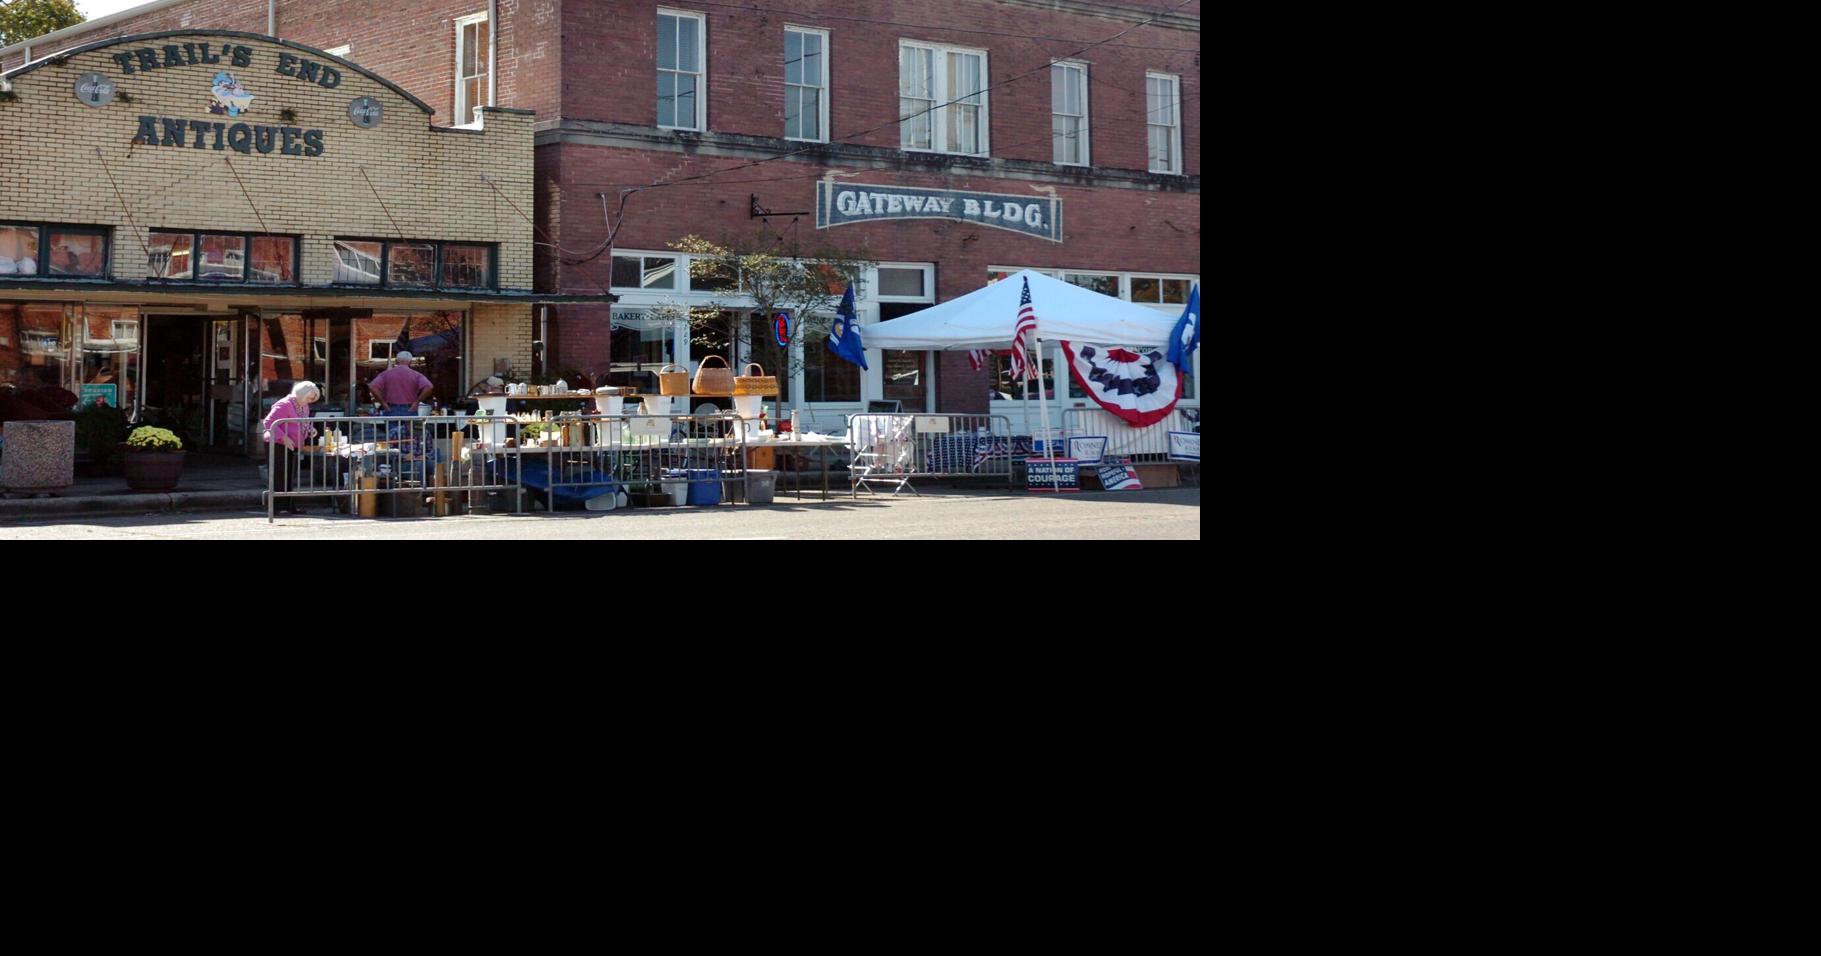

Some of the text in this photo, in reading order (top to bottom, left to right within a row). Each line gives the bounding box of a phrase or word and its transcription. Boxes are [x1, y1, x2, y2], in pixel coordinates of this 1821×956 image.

[113, 43, 341, 89] TRAIL'S END
[133, 116, 324, 157] ANTIQUES
[836, 190, 1049, 229] GATEWAY BLDG.
